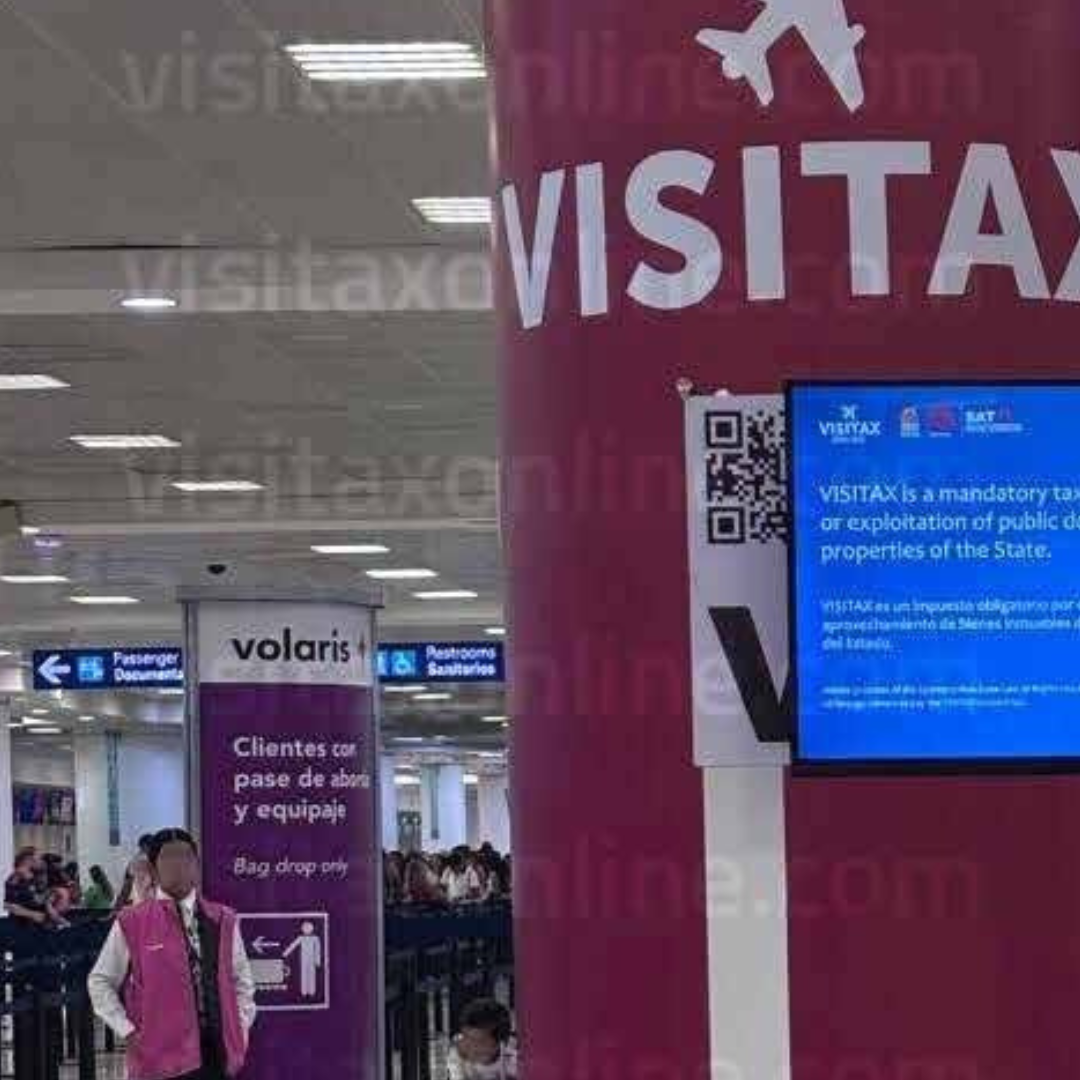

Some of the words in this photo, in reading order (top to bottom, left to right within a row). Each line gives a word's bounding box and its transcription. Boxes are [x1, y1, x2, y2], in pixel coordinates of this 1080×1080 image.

[818, 421, 881, 436] VISITAX
[818, 484, 899, 504] VISITAX
[902, 483, 917, 503] is
[923, 488, 934, 503] a
[939, 483, 1048, 506] mandatory
[820, 517, 842, 532] or
[847, 512, 966, 536] exploitation
[972, 511, 993, 531] of
[999, 512, 1058, 534] public
[821, 541, 924, 565] properties
[930, 538, 950, 559] of
[955, 538, 989, 559] the
[995, 540, 1052, 560] State.
[231, 627, 350, 662] volaris
[426, 645, 495, 660] Restrooms
[114, 652, 179, 667] Passenger
[428, 660, 496, 676] Sanitarios
[114, 668, 184, 681] Documenta
[233, 736, 326, 757] Clientes
[233, 772, 290, 793] pase
[298, 766, 325, 787] de
[233, 803, 249, 825] y
[257, 798, 346, 824] equipaje
[233, 857, 270, 878] Bag
[275, 856, 316, 879] drop
[321, 857, 348, 877] only
